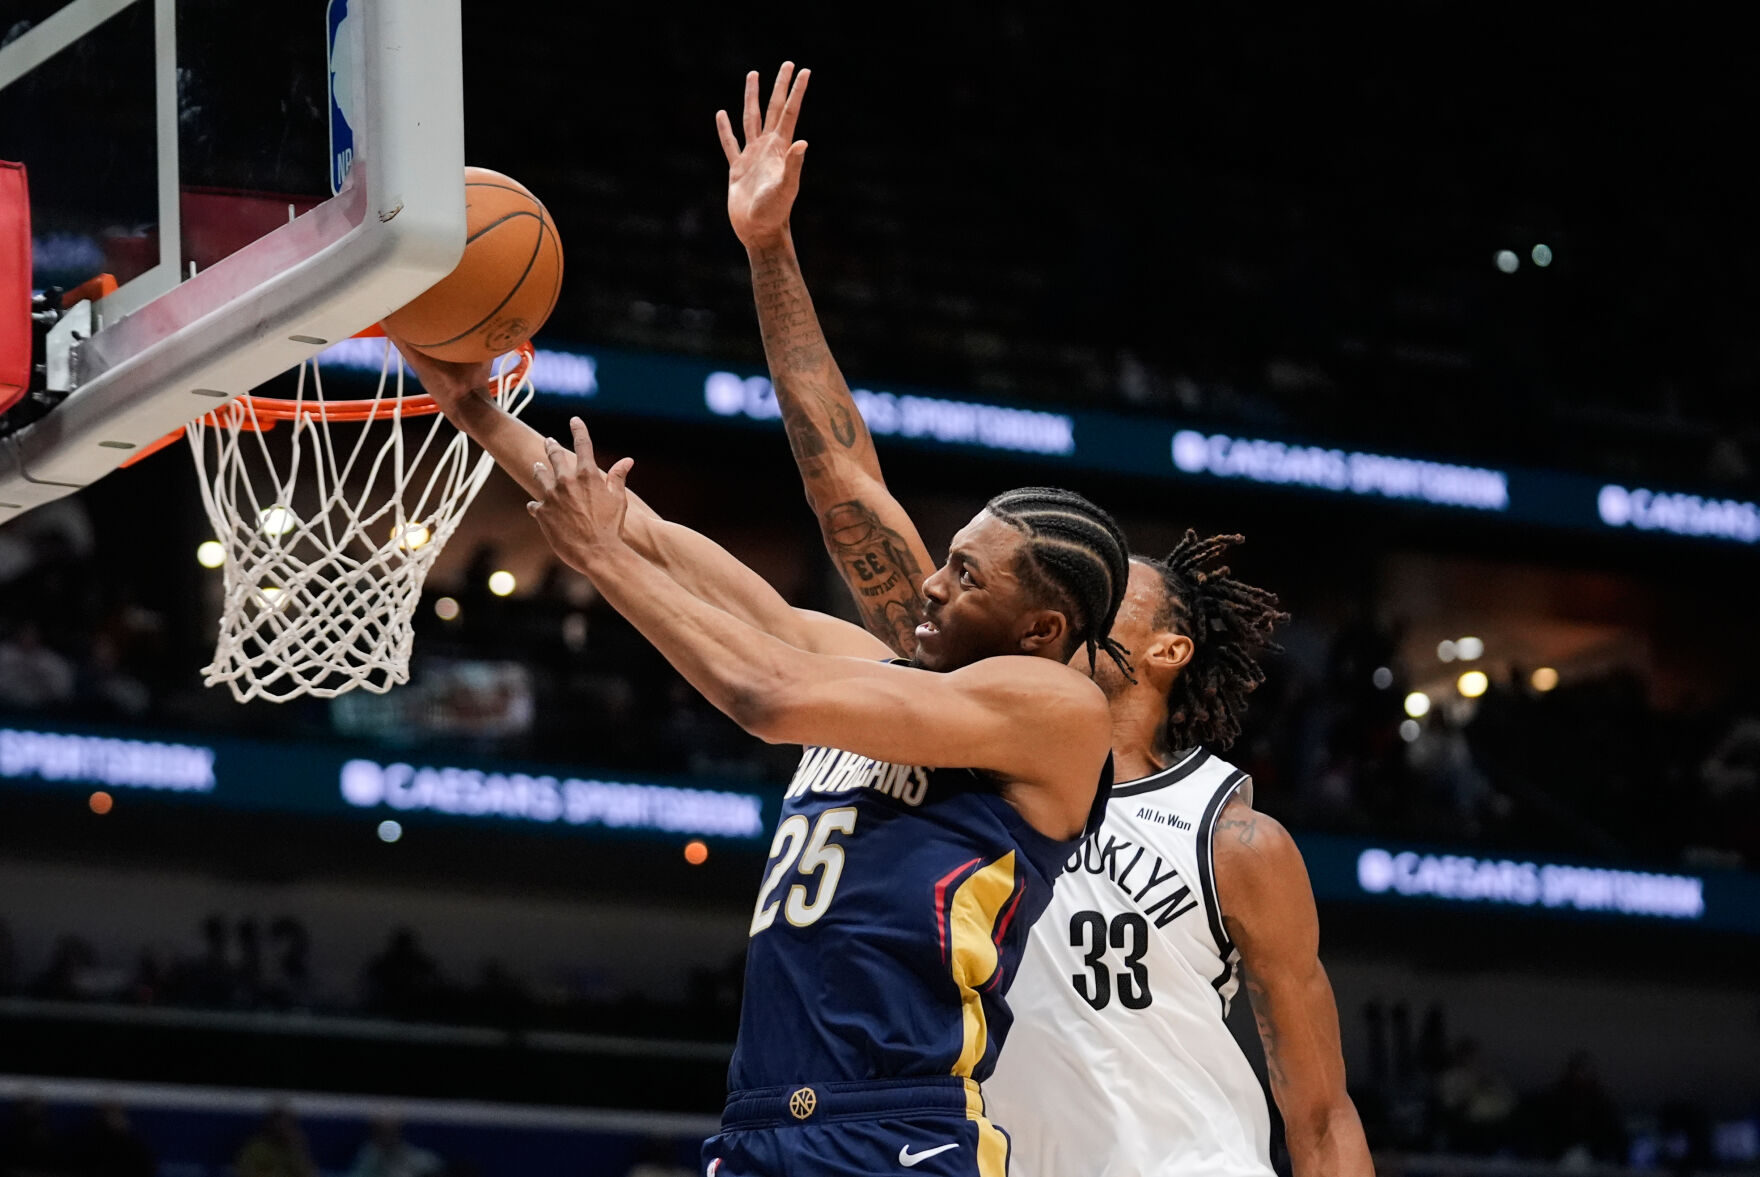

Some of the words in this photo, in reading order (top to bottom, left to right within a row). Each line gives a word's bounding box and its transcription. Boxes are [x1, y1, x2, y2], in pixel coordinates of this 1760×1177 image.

[337, 147, 352, 184] NB
[1136, 807, 1153, 821] All
[1154, 810, 1165, 824] In
[1167, 813, 1192, 831] Won
[750, 806, 858, 937] 25
[1069, 910, 1153, 1011] 33
